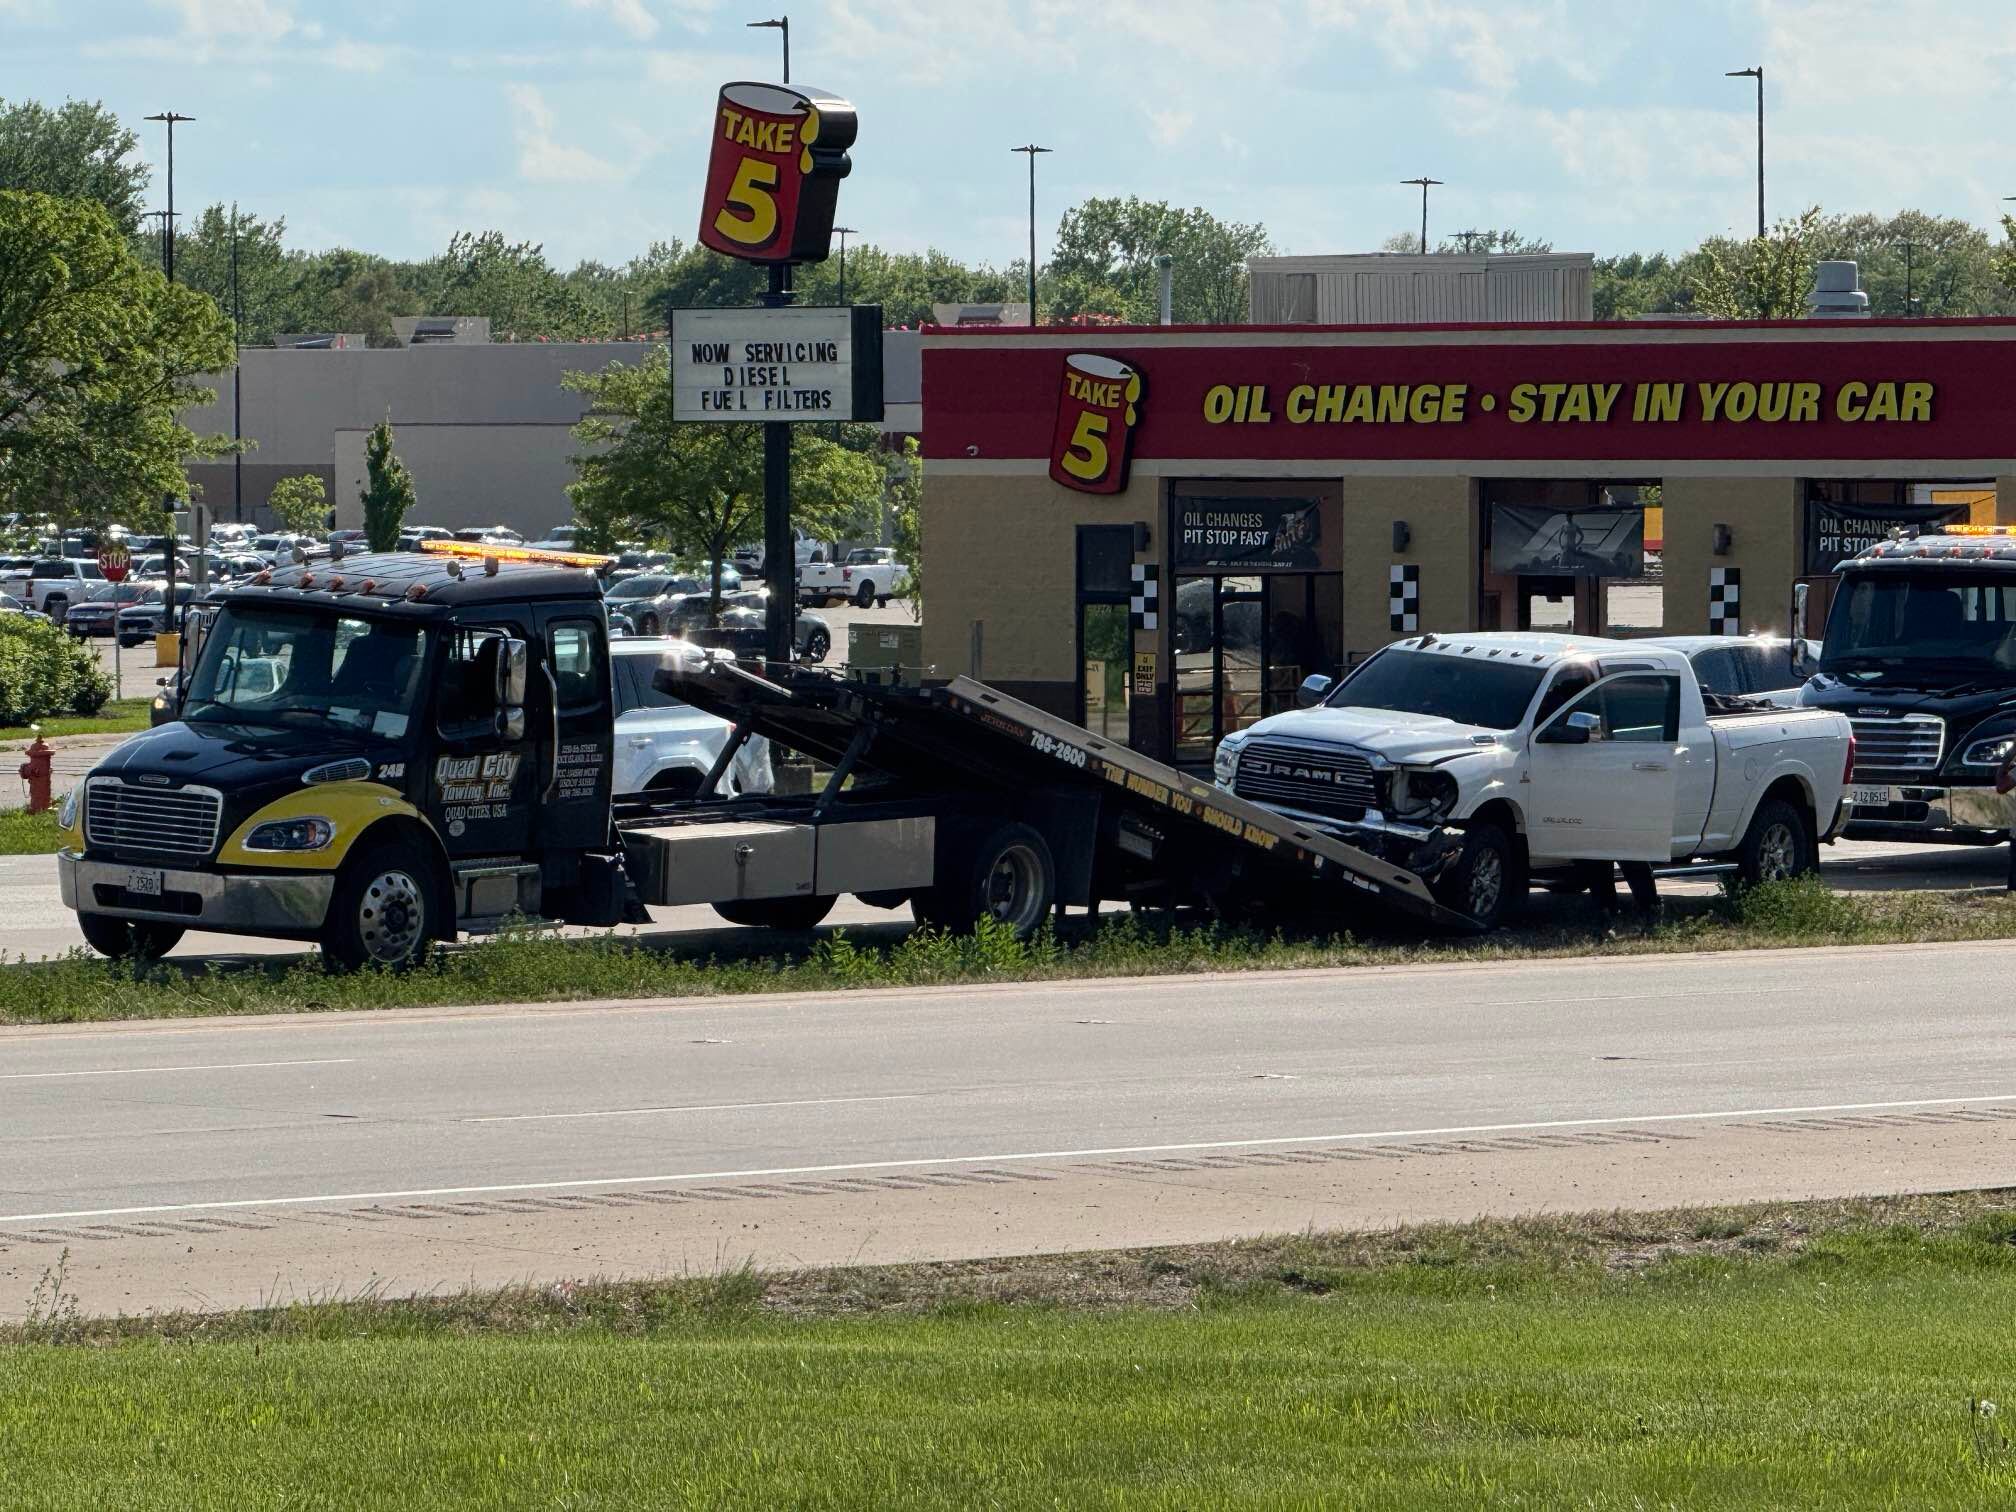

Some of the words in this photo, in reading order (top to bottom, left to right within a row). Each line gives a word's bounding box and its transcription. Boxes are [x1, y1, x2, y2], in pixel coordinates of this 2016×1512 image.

[722, 108, 795, 153] TAKE
[714, 158, 777, 244] 5
[692, 344, 729, 363] NOW
[745, 344, 838, 363] SERVICING
[724, 366, 791, 386] DIESEL
[701, 390, 747, 410] FUEL
[765, 389, 832, 410] FILTERS
[1066, 372, 1122, 408] TAKE
[1203, 385, 1271, 423] OIL
[1286, 384, 1467, 424] CHANGE
[1508, 383, 1622, 422] STAY
[1632, 383, 1684, 422] IN
[1699, 383, 1821, 422] YOUR
[1837, 382, 1934, 422] CAR
[1061, 411, 1108, 480] 5
[1184, 512, 1203, 527] OIL
[1206, 512, 1263, 528] CHANGES
[1819, 518, 1840, 534] OIL
[1184, 530, 1202, 545] PIT
[1206, 530, 1237, 545] STOP
[1240, 531, 1269, 546] FAST
[1819, 536, 1840, 552] PIT
[100, 552, 129, 569] STOP
[436, 756, 482, 784] Quad
[483, 752, 521, 780] City
[1273, 765, 1331, 781] RAM
[445, 806, 466, 822] QUAD
[493, 804, 507, 817] USA
[1171, 791, 1193, 815] YOU
[1203, 806, 1243, 836] SHOULD
